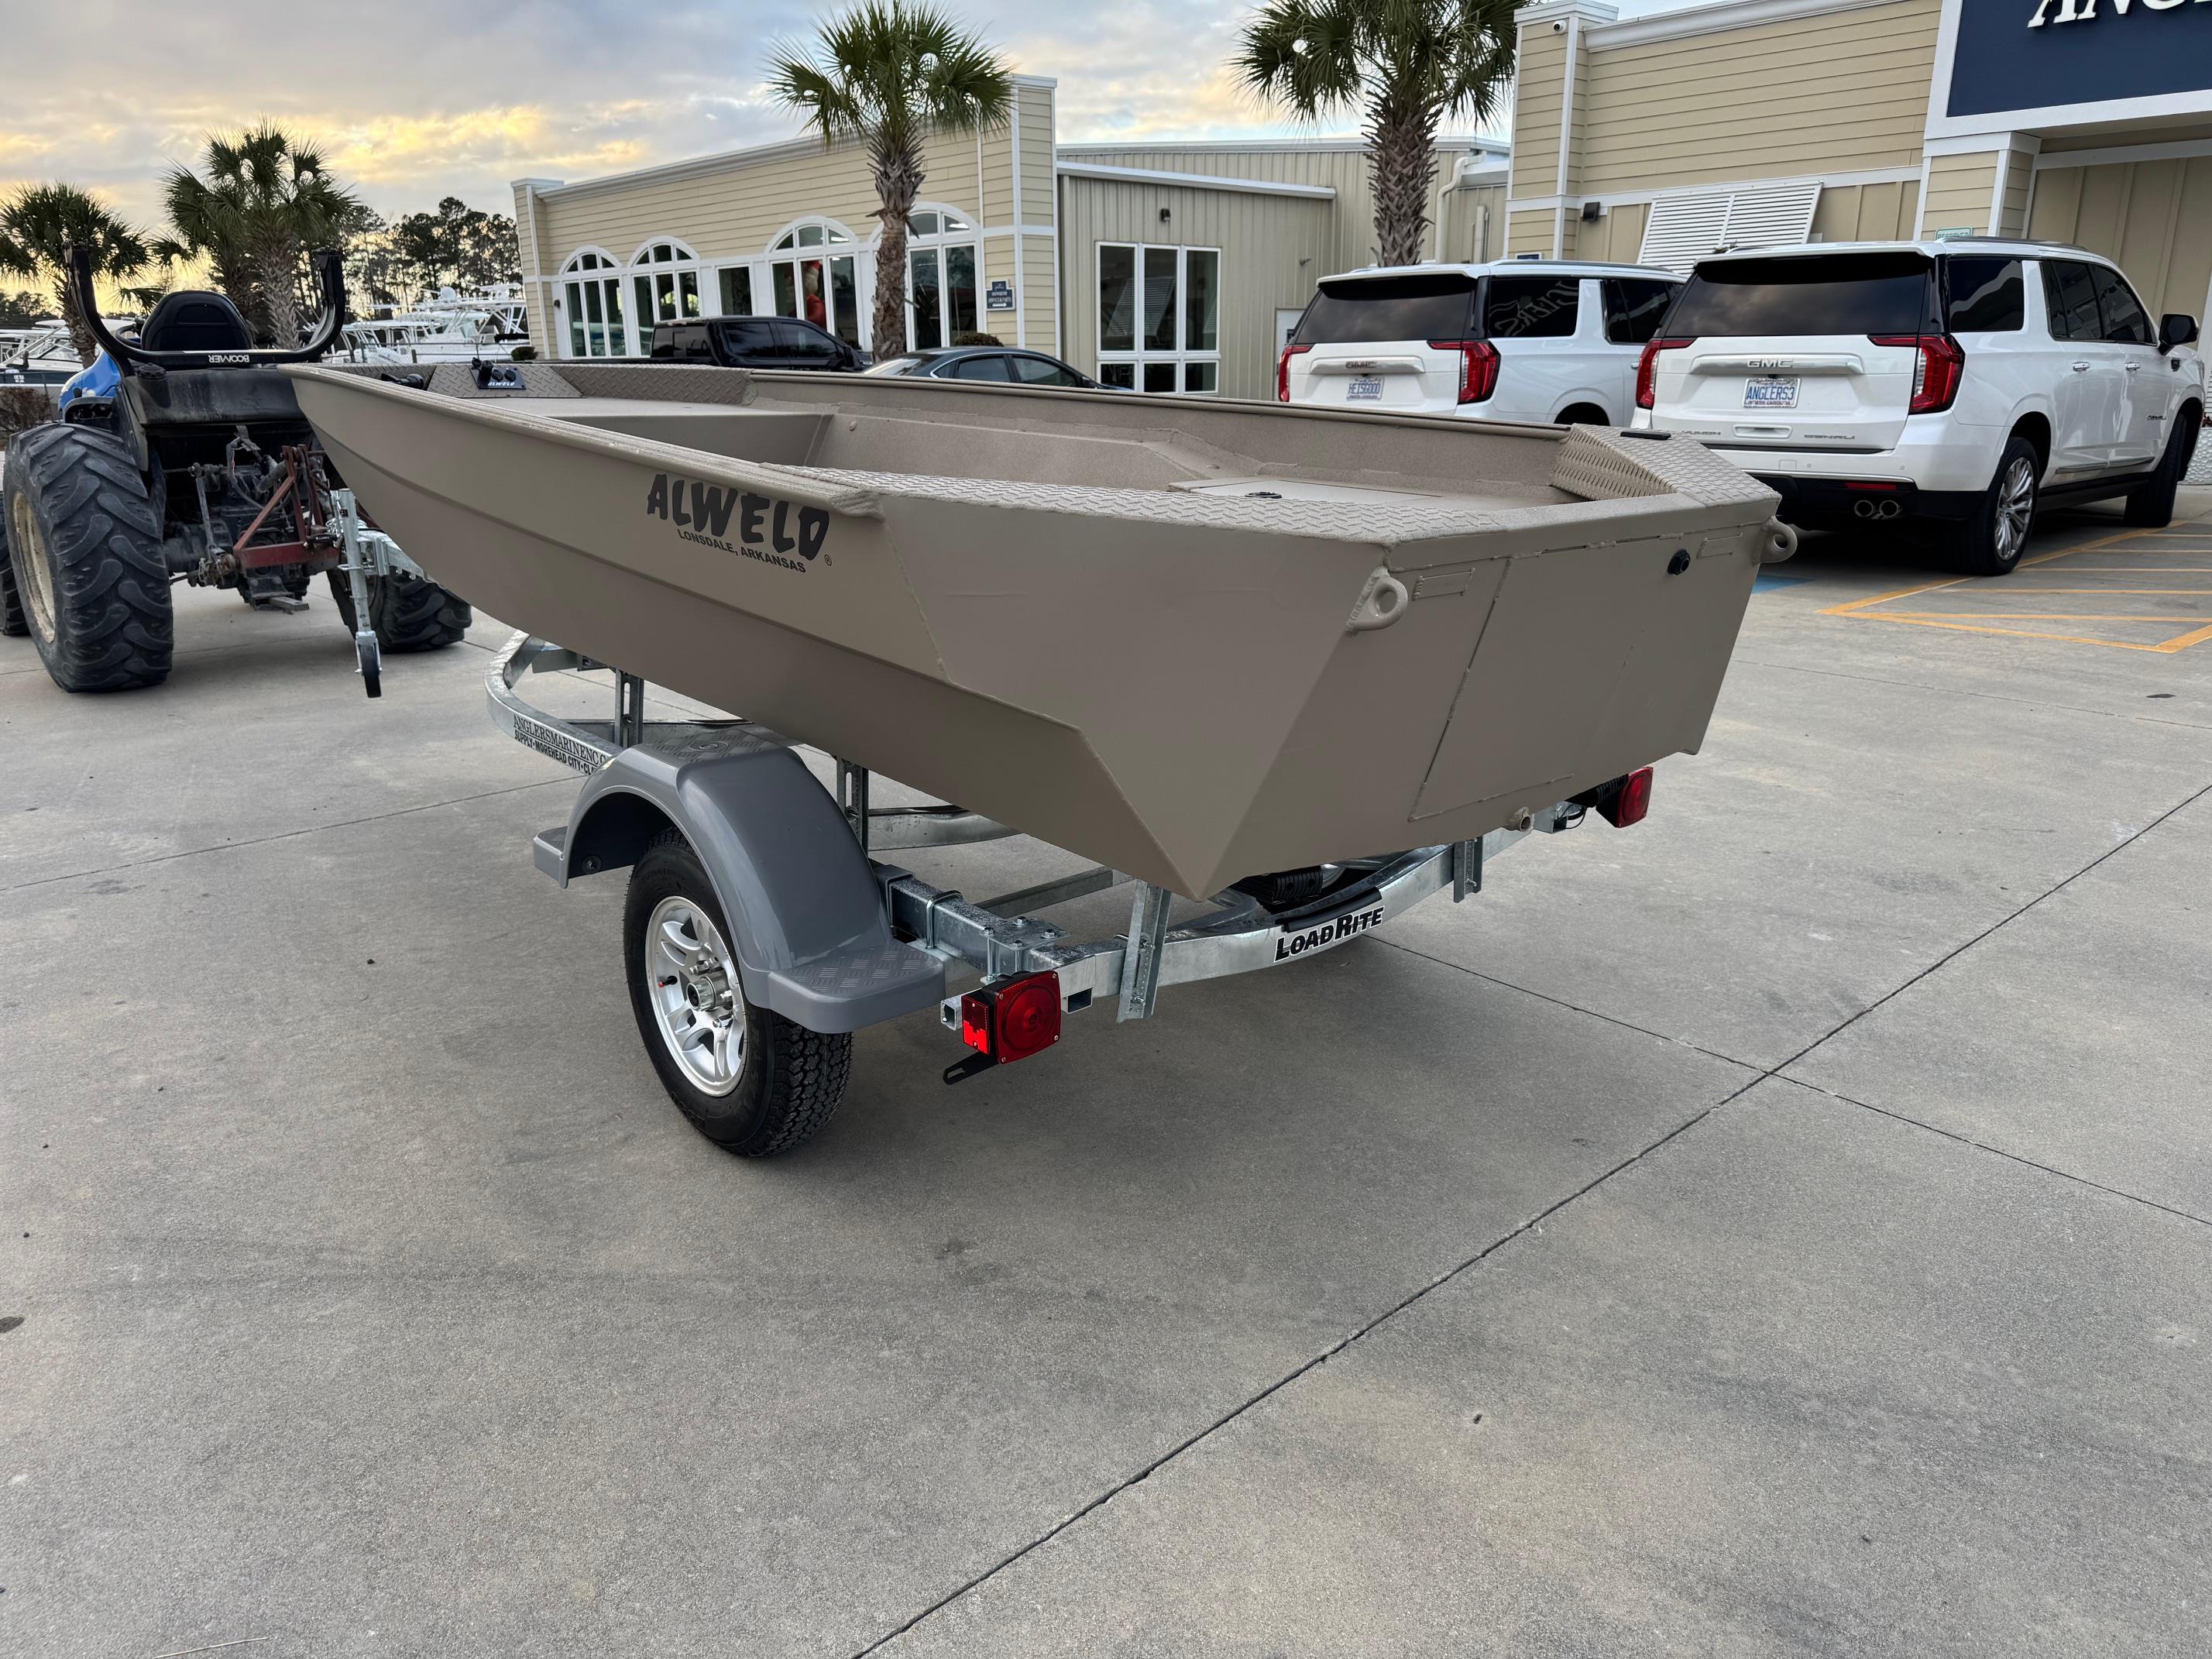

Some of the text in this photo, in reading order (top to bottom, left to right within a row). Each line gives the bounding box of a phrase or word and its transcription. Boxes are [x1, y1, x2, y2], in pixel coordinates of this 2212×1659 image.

[208, 355, 249, 363] BOOMER
[1747, 359, 1795, 368] GMC
[1746, 386, 1795, 400] ANGLERS3
[647, 474, 830, 561] ALWELD
[676, 528, 806, 573] LONSDALE, ARKANSAS
